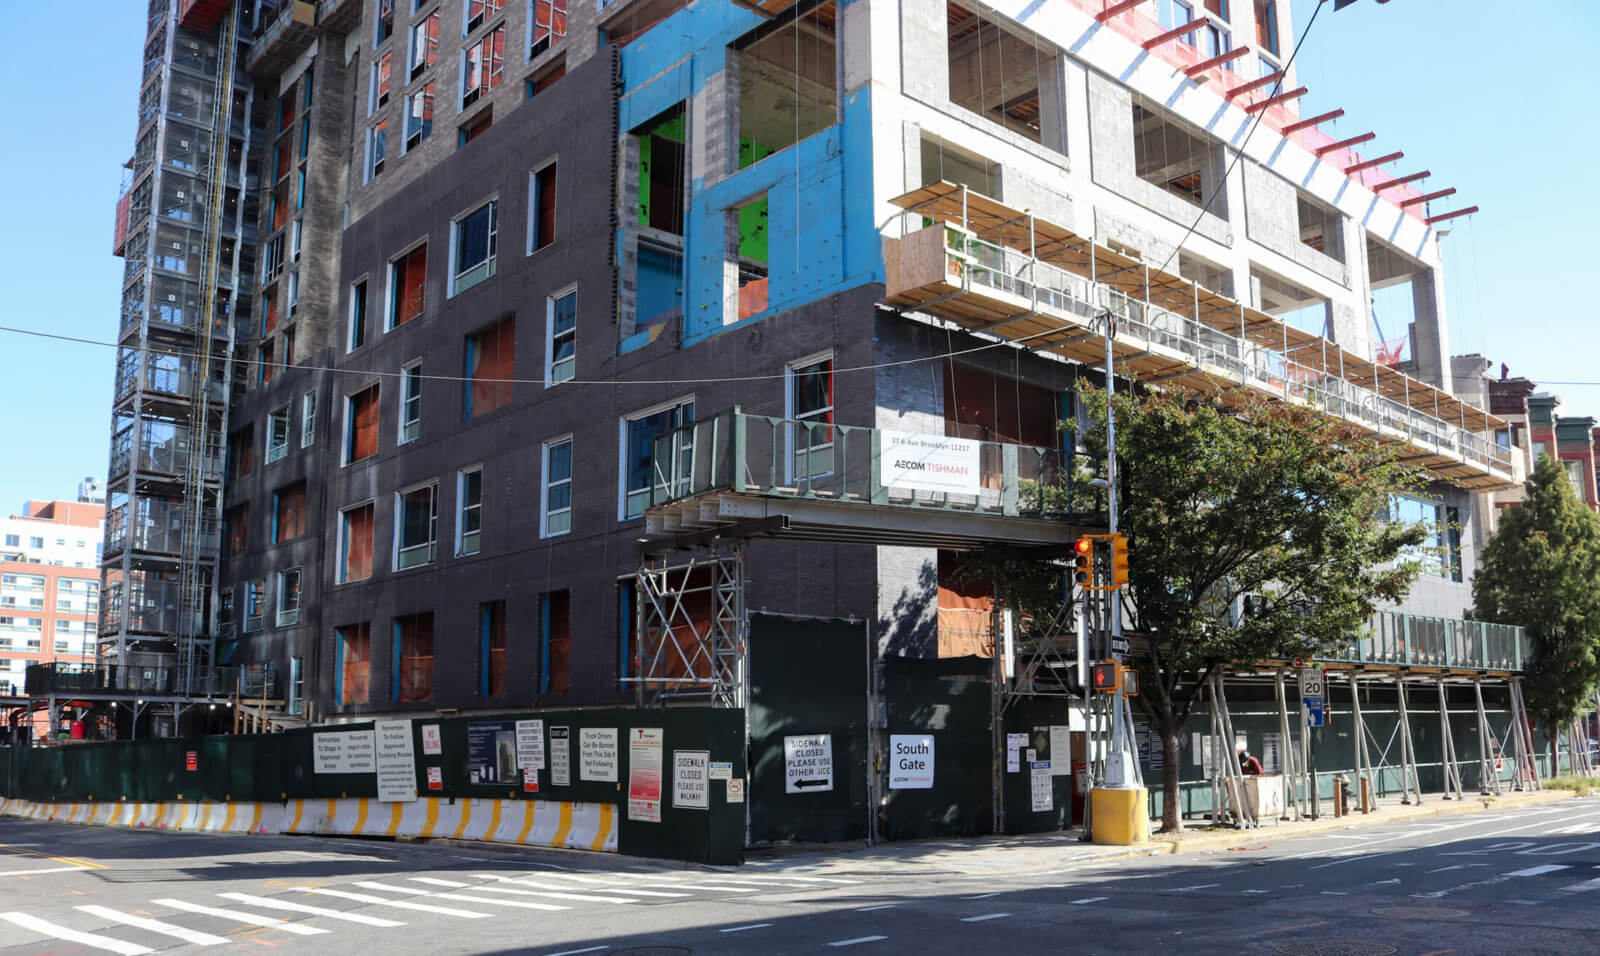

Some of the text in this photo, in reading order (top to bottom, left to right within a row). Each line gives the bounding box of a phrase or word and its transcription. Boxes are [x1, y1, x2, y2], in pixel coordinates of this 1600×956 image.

[920, 440, 949, 450] Brooklyn
[951, 443, 970, 452] 11217
[894, 459, 968, 475] AECOM TISHMAN
[1305, 682, 1320, 693] 20
[791, 739, 827, 748] SIDEWALK
[896, 742, 929, 754] South
[796, 748, 824, 757] CLOSED
[678, 758, 704, 767] SIDEWALK
[788, 757, 831, 767] PLEASE USE
[899, 758, 925, 770] Gate
[680, 770, 702, 780] CLOSED
[789, 768, 813, 777] OTHER
[678, 782, 704, 791] PLEASE USE
